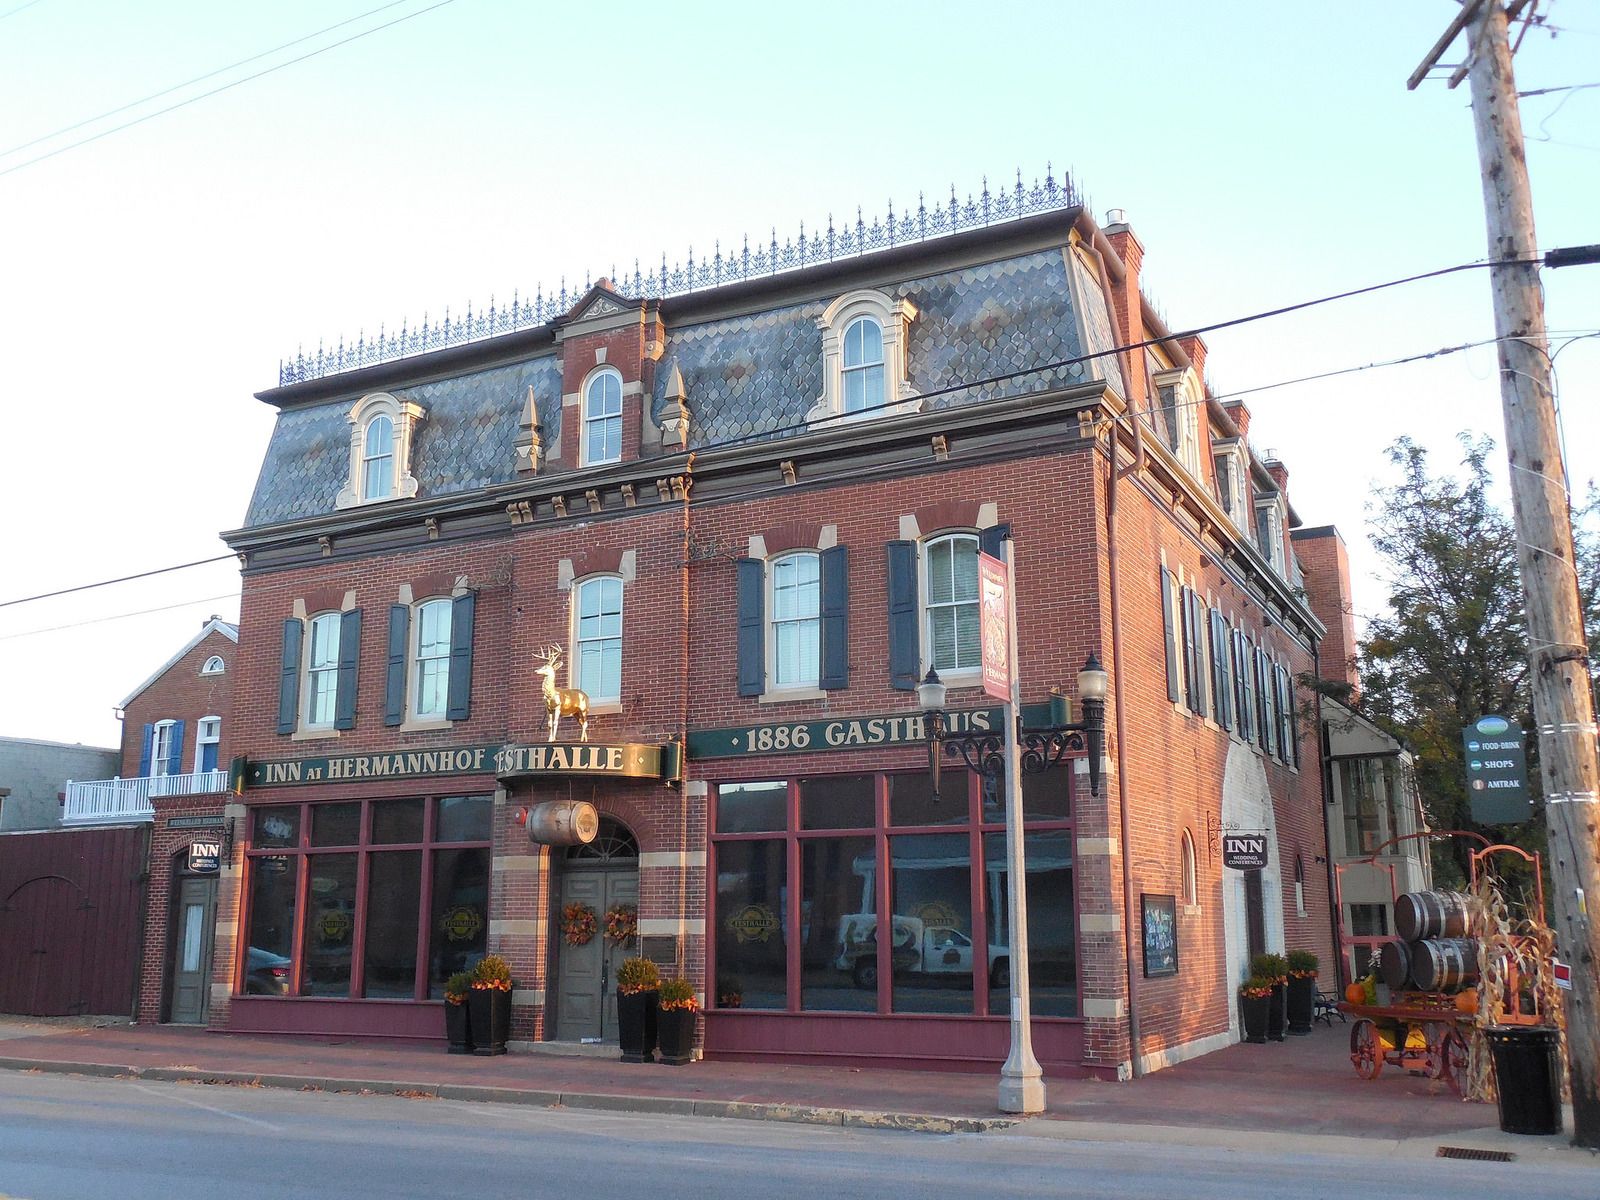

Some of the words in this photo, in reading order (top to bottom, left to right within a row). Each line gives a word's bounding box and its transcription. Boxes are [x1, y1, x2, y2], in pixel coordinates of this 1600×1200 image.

[746, 725, 811, 752] 1886
[824, 711, 991, 746] GASTHUS
[265, 762, 302, 783] INN
[306, 768, 322, 780] AT
[327, 749, 486, 779] HERMANNHOF
[493, 747, 624, 773] ESTHALLE
[1484, 760, 1514, 769] SHOPS
[1487, 780, 1520, 789] AMTRAK
[191, 843, 220, 857] INN
[1226, 839, 1264, 853] INN
